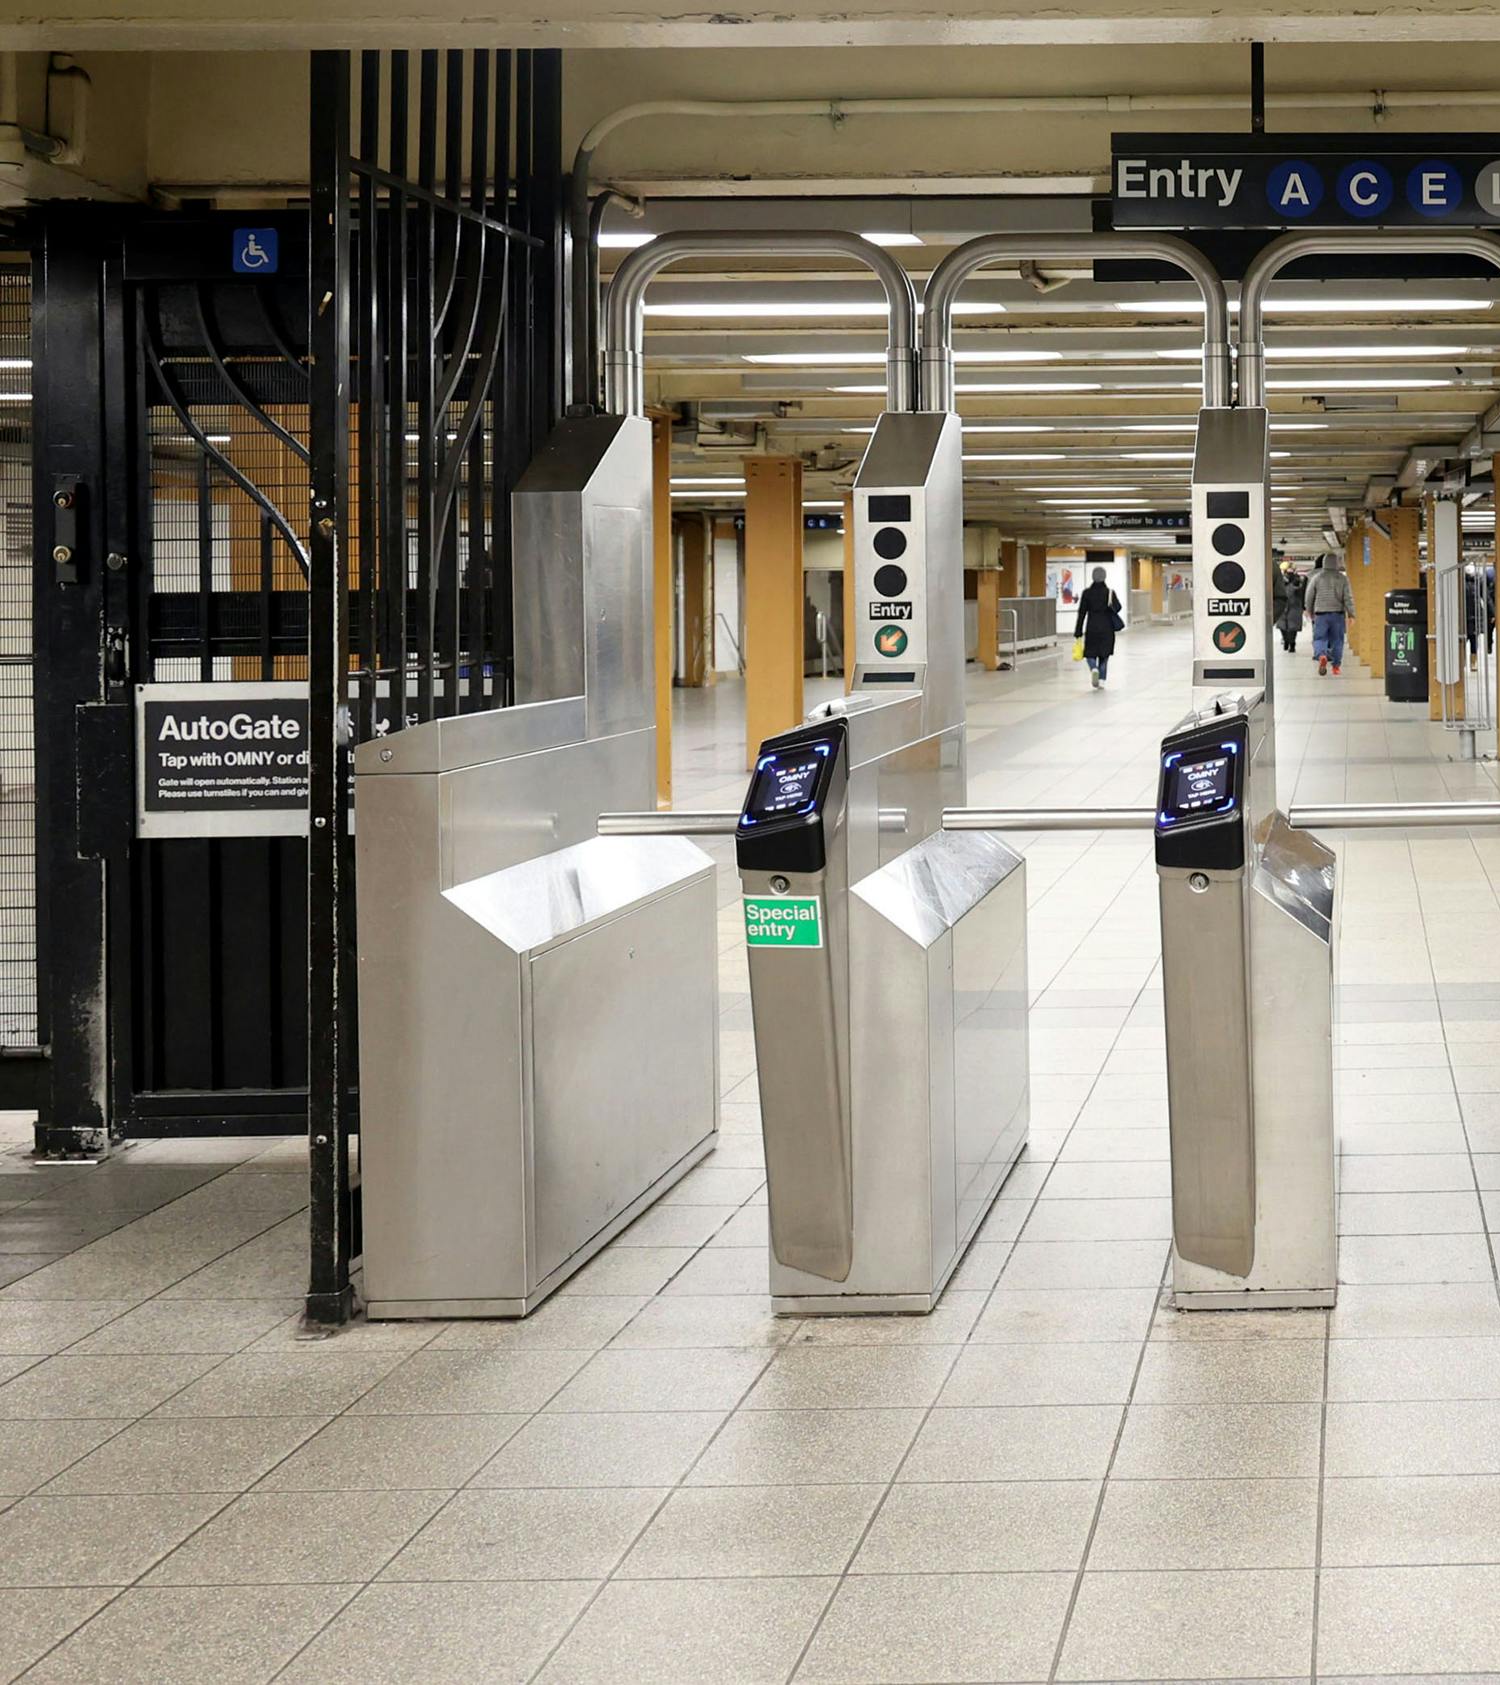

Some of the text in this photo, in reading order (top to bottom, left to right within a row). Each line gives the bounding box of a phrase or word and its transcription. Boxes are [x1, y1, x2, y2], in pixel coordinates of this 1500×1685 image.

[1117, 159, 1242, 206] Entry
[1280, 173, 1309, 205] A
[1349, 172, 1379, 206] C
[1421, 173, 1447, 205] E
[871, 603, 911, 619] Entry
[1209, 599, 1249, 615] Entry
[158, 714, 300, 741] AutoGate
[158, 753, 187, 769] Tap
[190, 752, 222, 767] with
[224, 751, 274, 766] OMNY
[277, 754, 294, 765] or
[158, 778, 179, 787] Gate
[180, 778, 193, 786] will
[194, 779, 215, 788] open
[216, 777, 271, 787] automatically.
[272, 776, 298, 785] Station
[779, 770, 810, 784] OMNY
[1187, 768, 1219, 780] OMNY
[158, 789, 187, 798] Please
[204, 789, 240, 797] turnstiles
[241, 788, 248, 797] if
[248, 790, 264, 798] you
[280, 788, 296, 796] and
[746, 904, 815, 922] Special
[747, 922, 796, 940] entry
